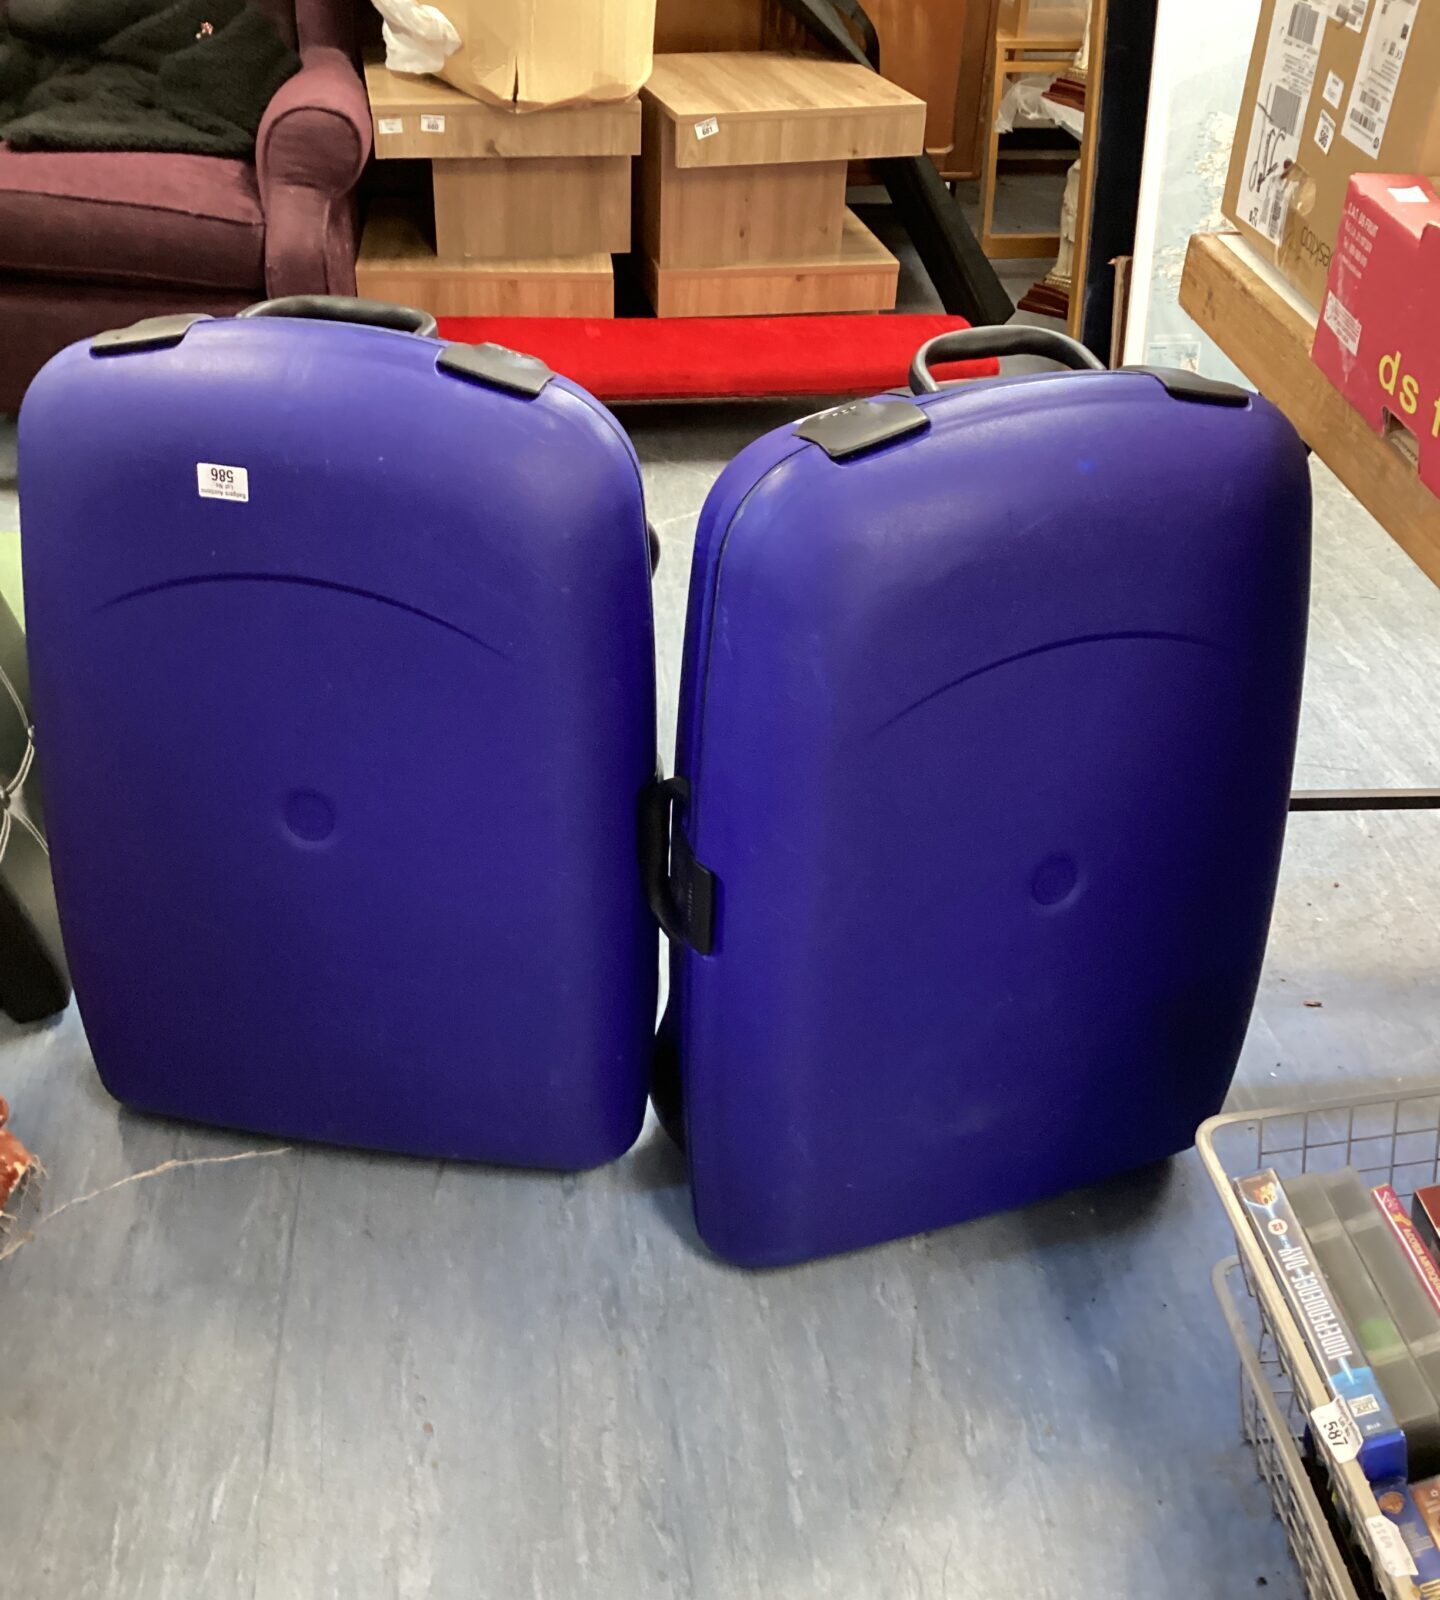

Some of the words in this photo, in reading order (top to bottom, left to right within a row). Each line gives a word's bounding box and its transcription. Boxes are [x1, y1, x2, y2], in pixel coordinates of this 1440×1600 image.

[1379, 350, 1419, 414] ds
[211, 468, 234, 483] 586
[1278, 1246, 1310, 1271] DAY
[1291, 1271, 1353, 1360] INDEPENDENCE
[1323, 1420, 1349, 1446] 587
